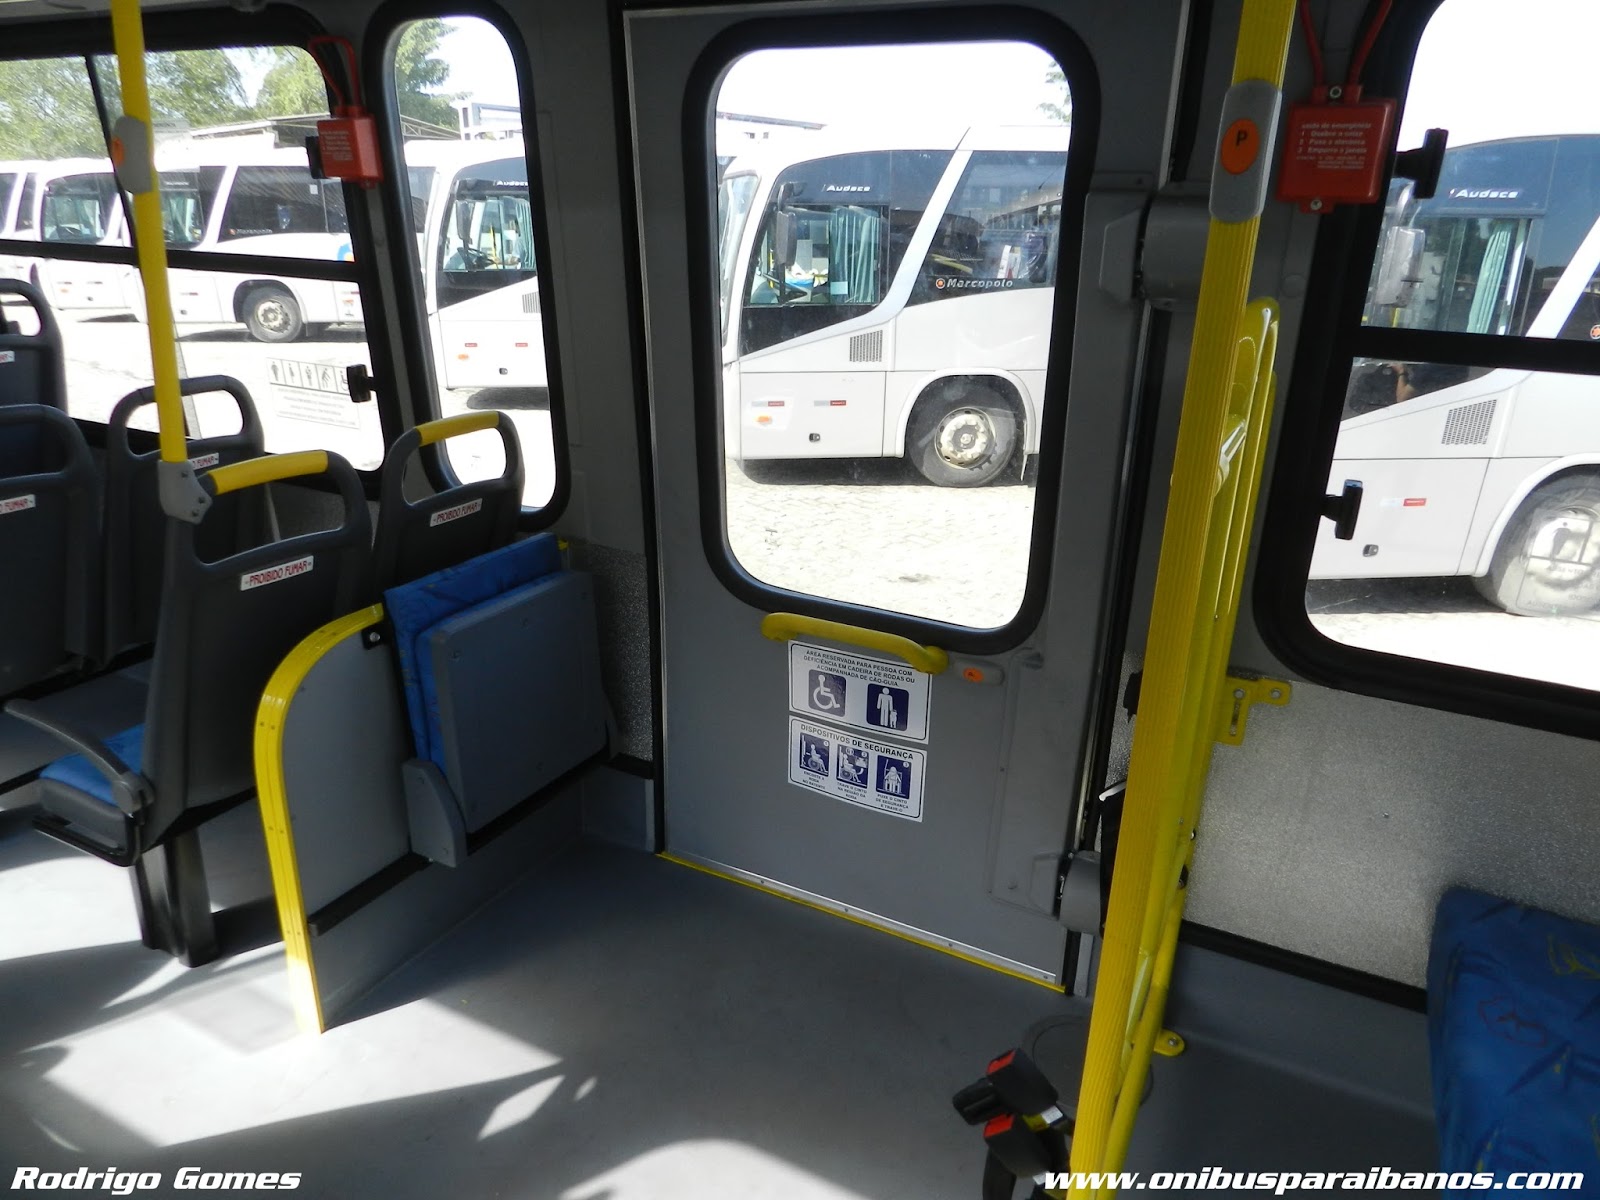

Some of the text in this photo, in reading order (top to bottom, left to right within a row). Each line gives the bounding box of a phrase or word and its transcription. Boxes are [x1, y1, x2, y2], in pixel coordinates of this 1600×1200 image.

[1236, 130, 1248, 147] P
[946, 278, 1013, 289] Marcopolo
[461, 502, 478, 516] FUMAR
[249, 560, 308, 587] PROIBIDO FUMAR
[816, 664, 860, 678] ACOMPANHADA
[822, 653, 856, 665] RESERVADA
[873, 665, 898, 674] PESSOA
[847, 665, 873, 675] CADEIRA
[883, 673, 905, 681] RODAS
[800, 723, 914, 760] DISPOSITIVOS DE SEGURANÇA
[894, 797, 908, 805] CINTO
